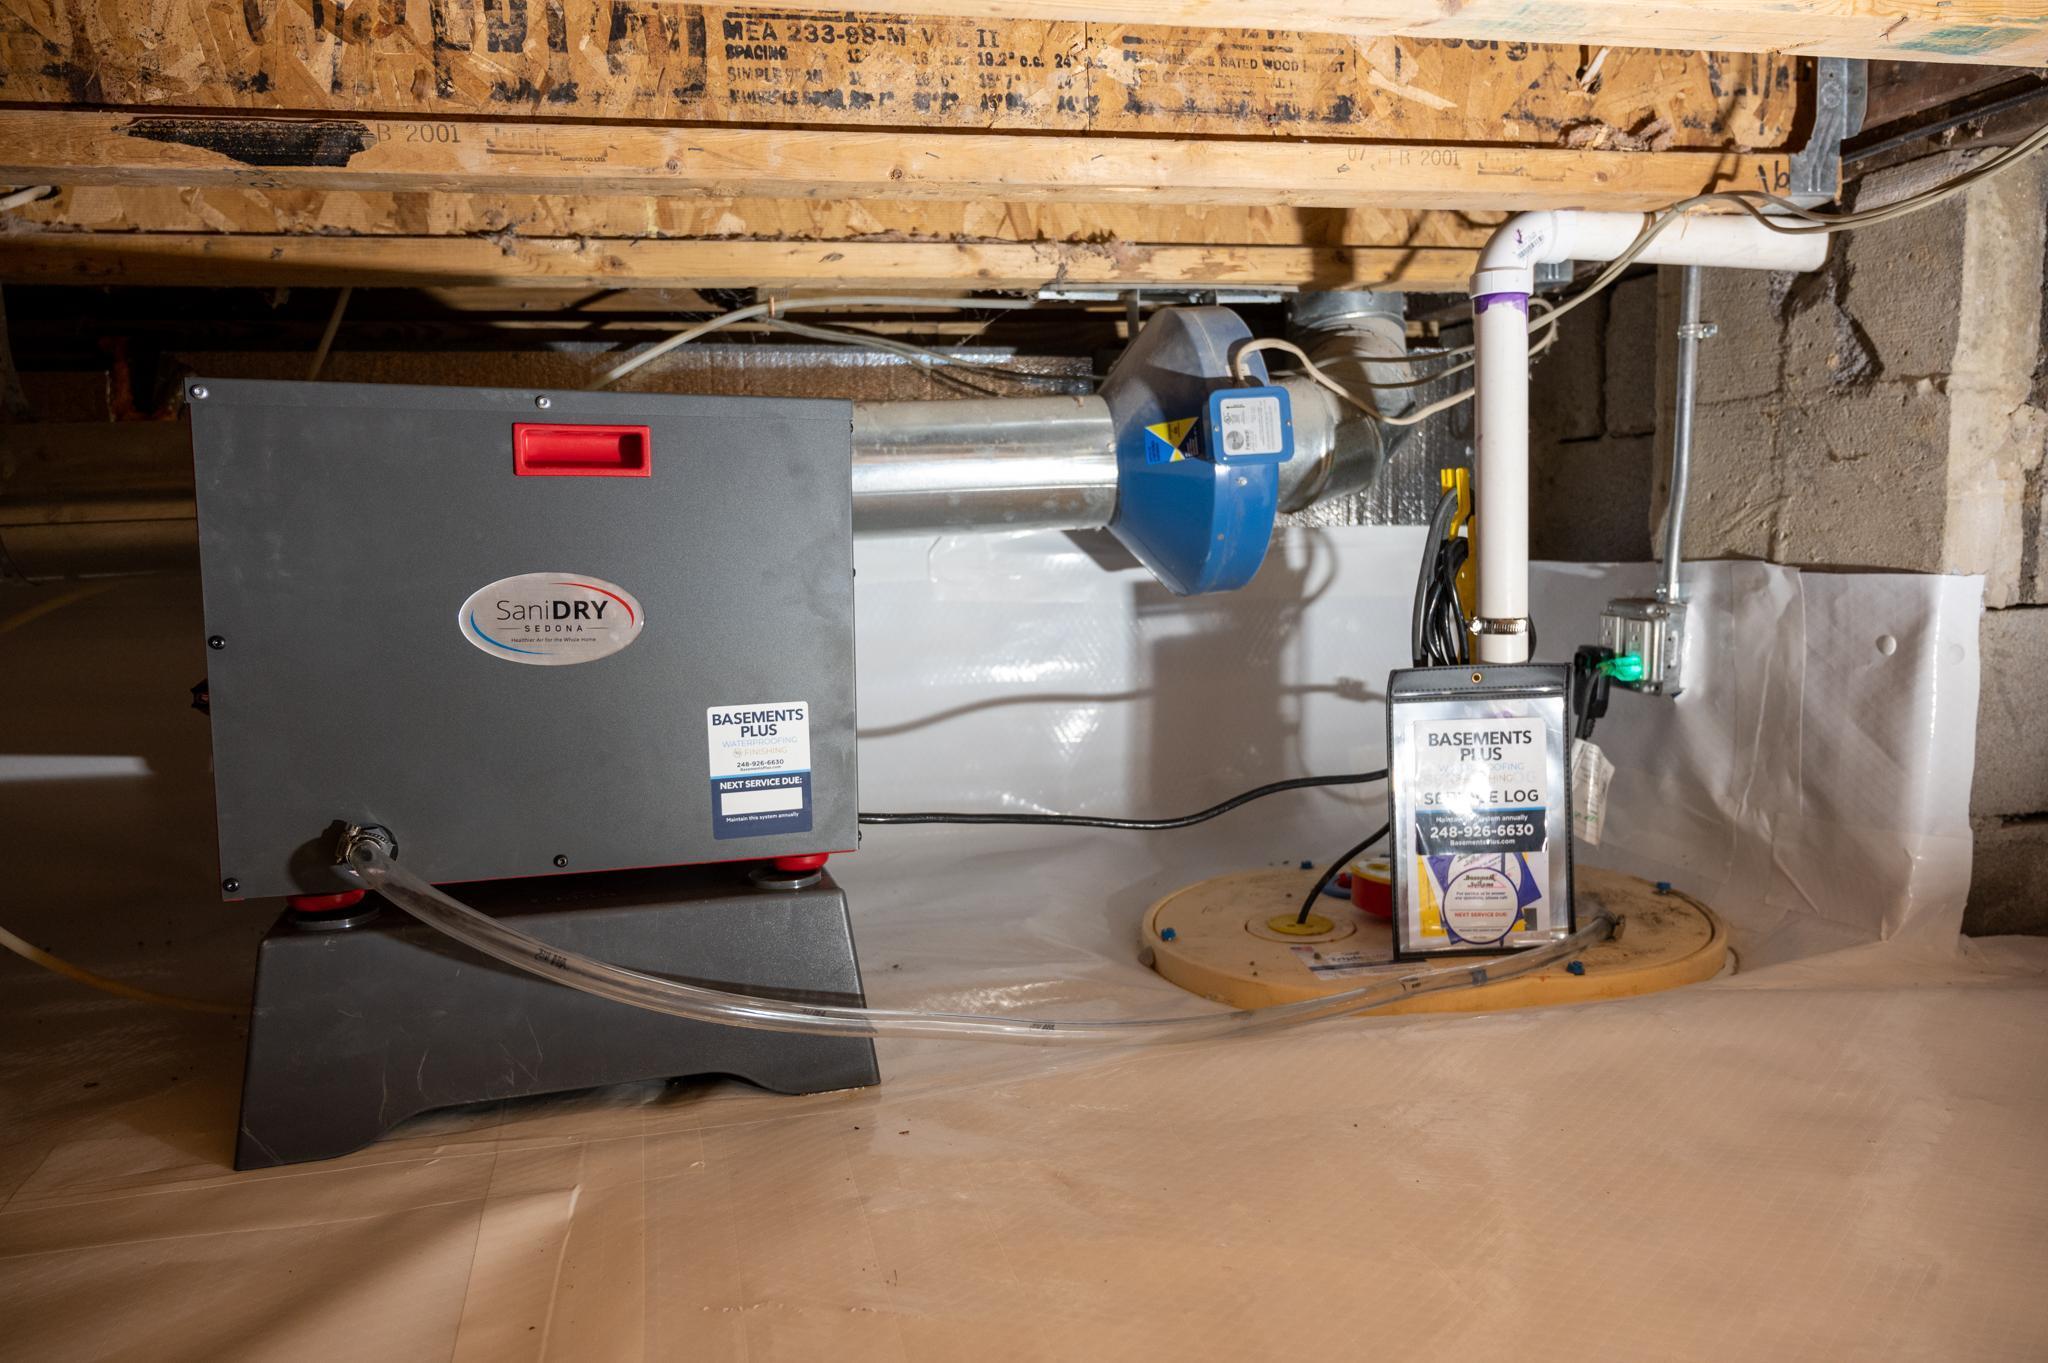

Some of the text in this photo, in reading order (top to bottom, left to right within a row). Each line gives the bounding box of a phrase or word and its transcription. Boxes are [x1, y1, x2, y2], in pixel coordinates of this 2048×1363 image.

[722, 19, 778, 41] MEA
[406, 124, 461, 144] 2001
[1420, 149, 1459, 167] 2001
[496, 599, 609, 621] SaniDRY
[525, 625, 584, 633] SEDONA
[712, 708, 804, 726] BASEMENTS
[741, 723, 777, 738] PLUS
[722, 736, 798, 748] WATERPROOFING
[1428, 730, 1532, 747] BASEMENTS
[744, 746, 788, 757] FINISHING
[1460, 746, 1502, 762] PLUS
[737, 759, 784, 768] 248-926-6630
[720, 776, 802, 790] NEXT SERVICE DUE:
[1504, 789, 1539, 803] LOG
[759, 814, 777, 823] system
[1502, 813, 1528, 822] annually
[1430, 823, 1534, 839] 248-926-6630
